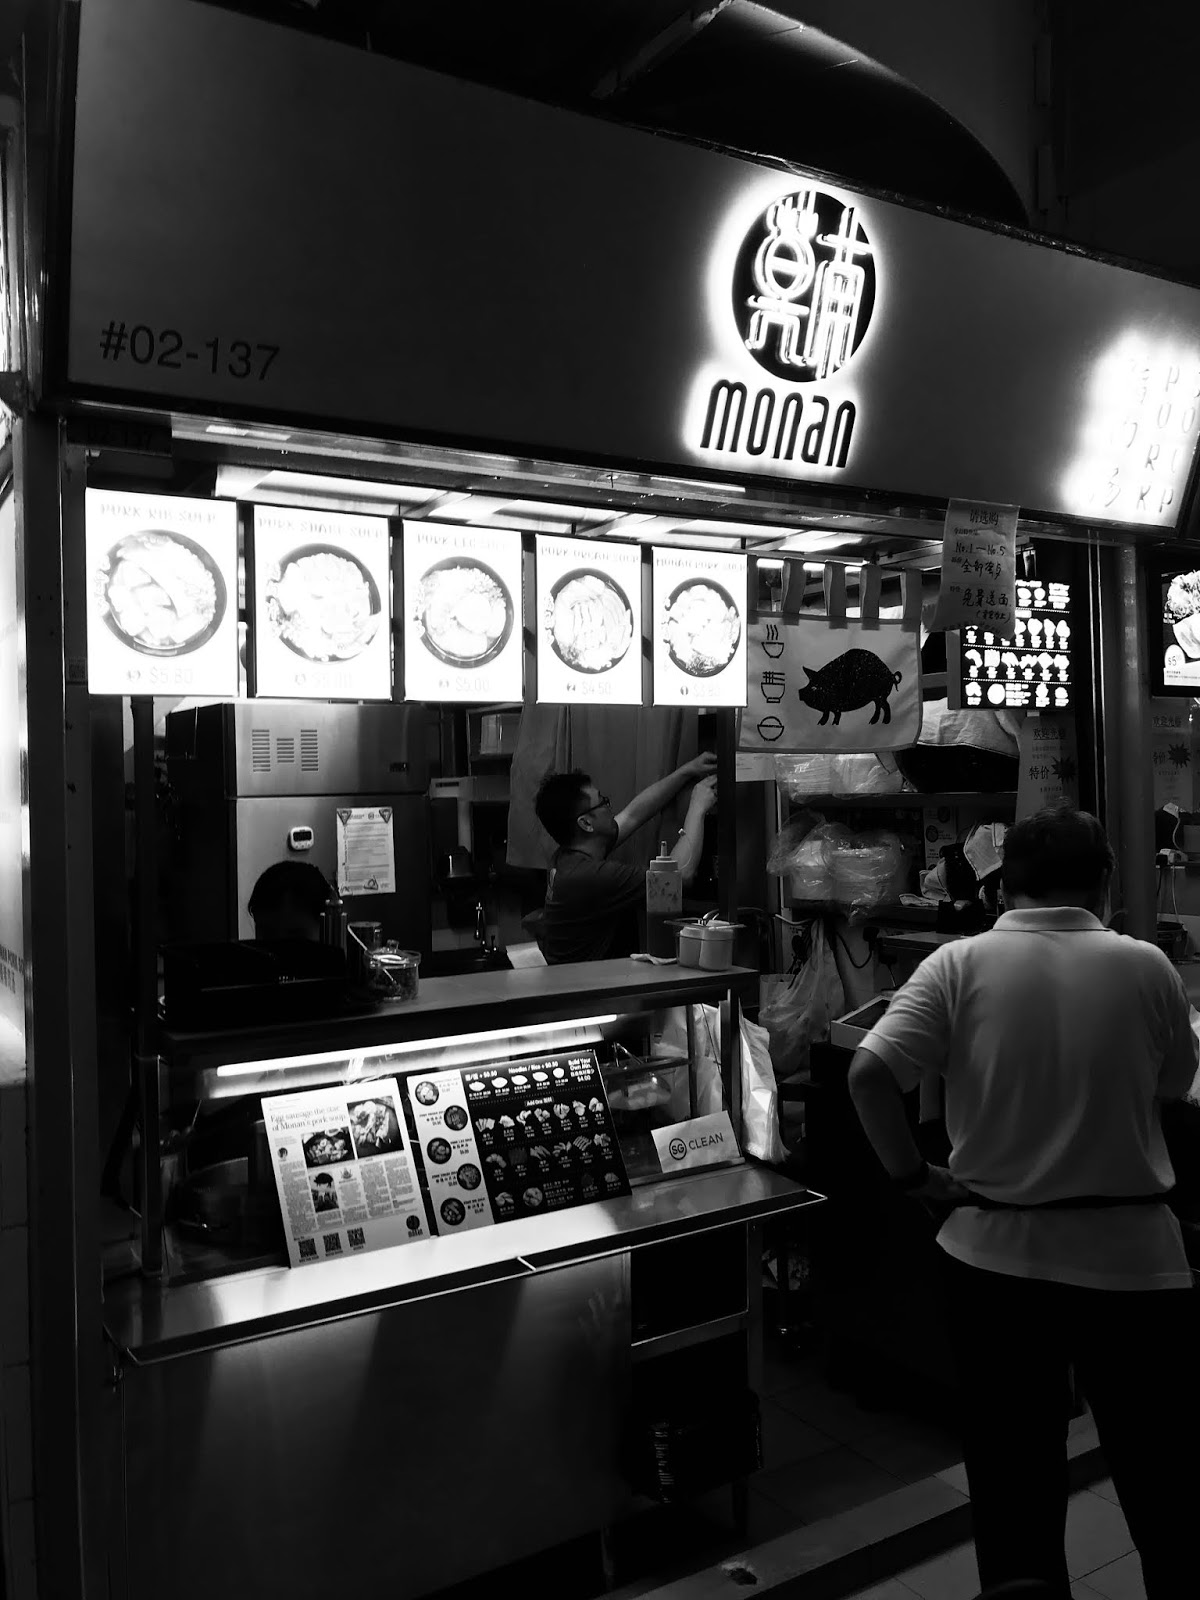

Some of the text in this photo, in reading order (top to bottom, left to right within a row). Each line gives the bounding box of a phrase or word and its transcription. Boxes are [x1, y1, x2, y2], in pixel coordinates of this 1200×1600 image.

[99, 320, 280, 381] #02-137
[700, 379, 856, 469] monan
[1029, 765, 1050, 780] 特价
[312, 1116, 328, 1128] pork
[688, 1132, 724, 1151] CLEAN
